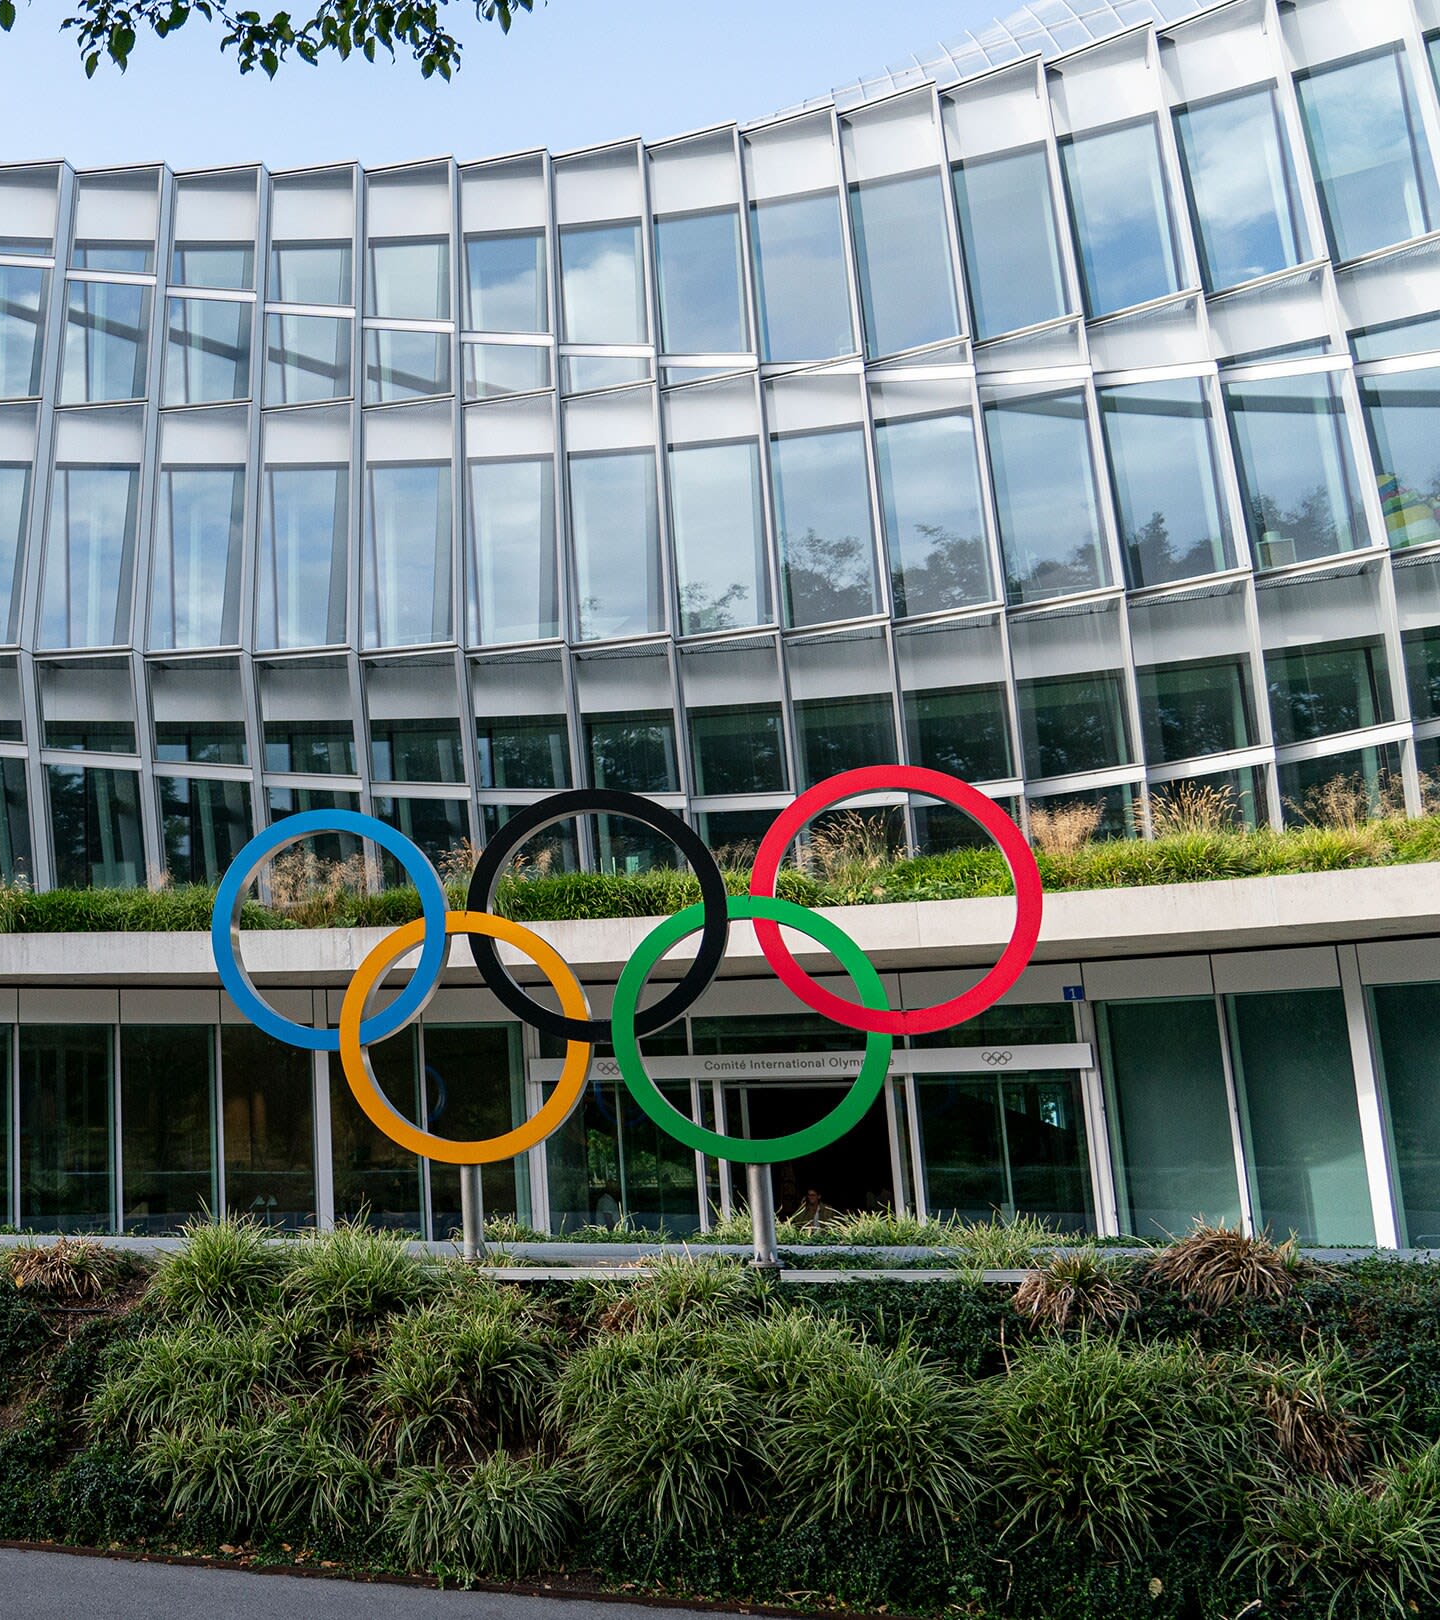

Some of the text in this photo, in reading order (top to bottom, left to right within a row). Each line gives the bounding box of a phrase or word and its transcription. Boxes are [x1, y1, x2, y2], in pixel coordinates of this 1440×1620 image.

[1069, 987, 1077, 999] 1
[704, 1060, 746, 1071] Comité
[750, 1058, 825, 1070] International
